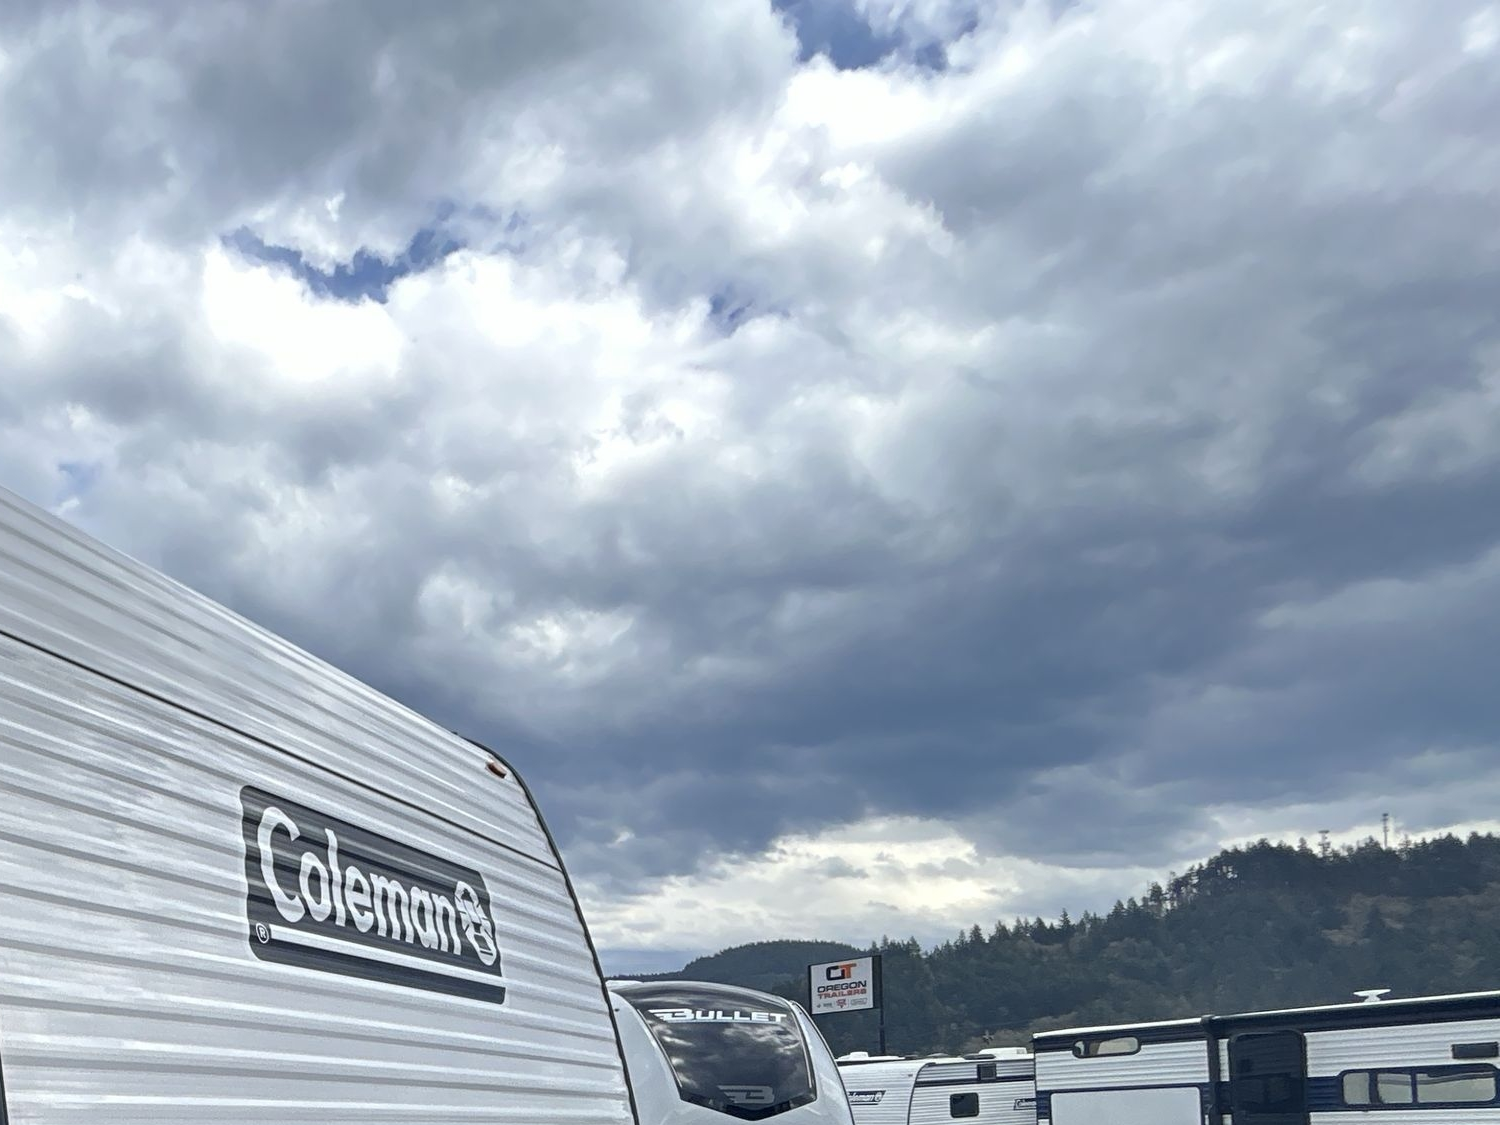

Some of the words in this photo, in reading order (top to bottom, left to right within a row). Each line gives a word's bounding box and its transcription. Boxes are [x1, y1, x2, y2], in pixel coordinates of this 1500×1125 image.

[257, 806, 461, 955] Coleman
[817, 980, 867, 993] OREGON
[817, 988, 867, 1000] TRAILERS
[648, 1008, 787, 1023] BULLET
